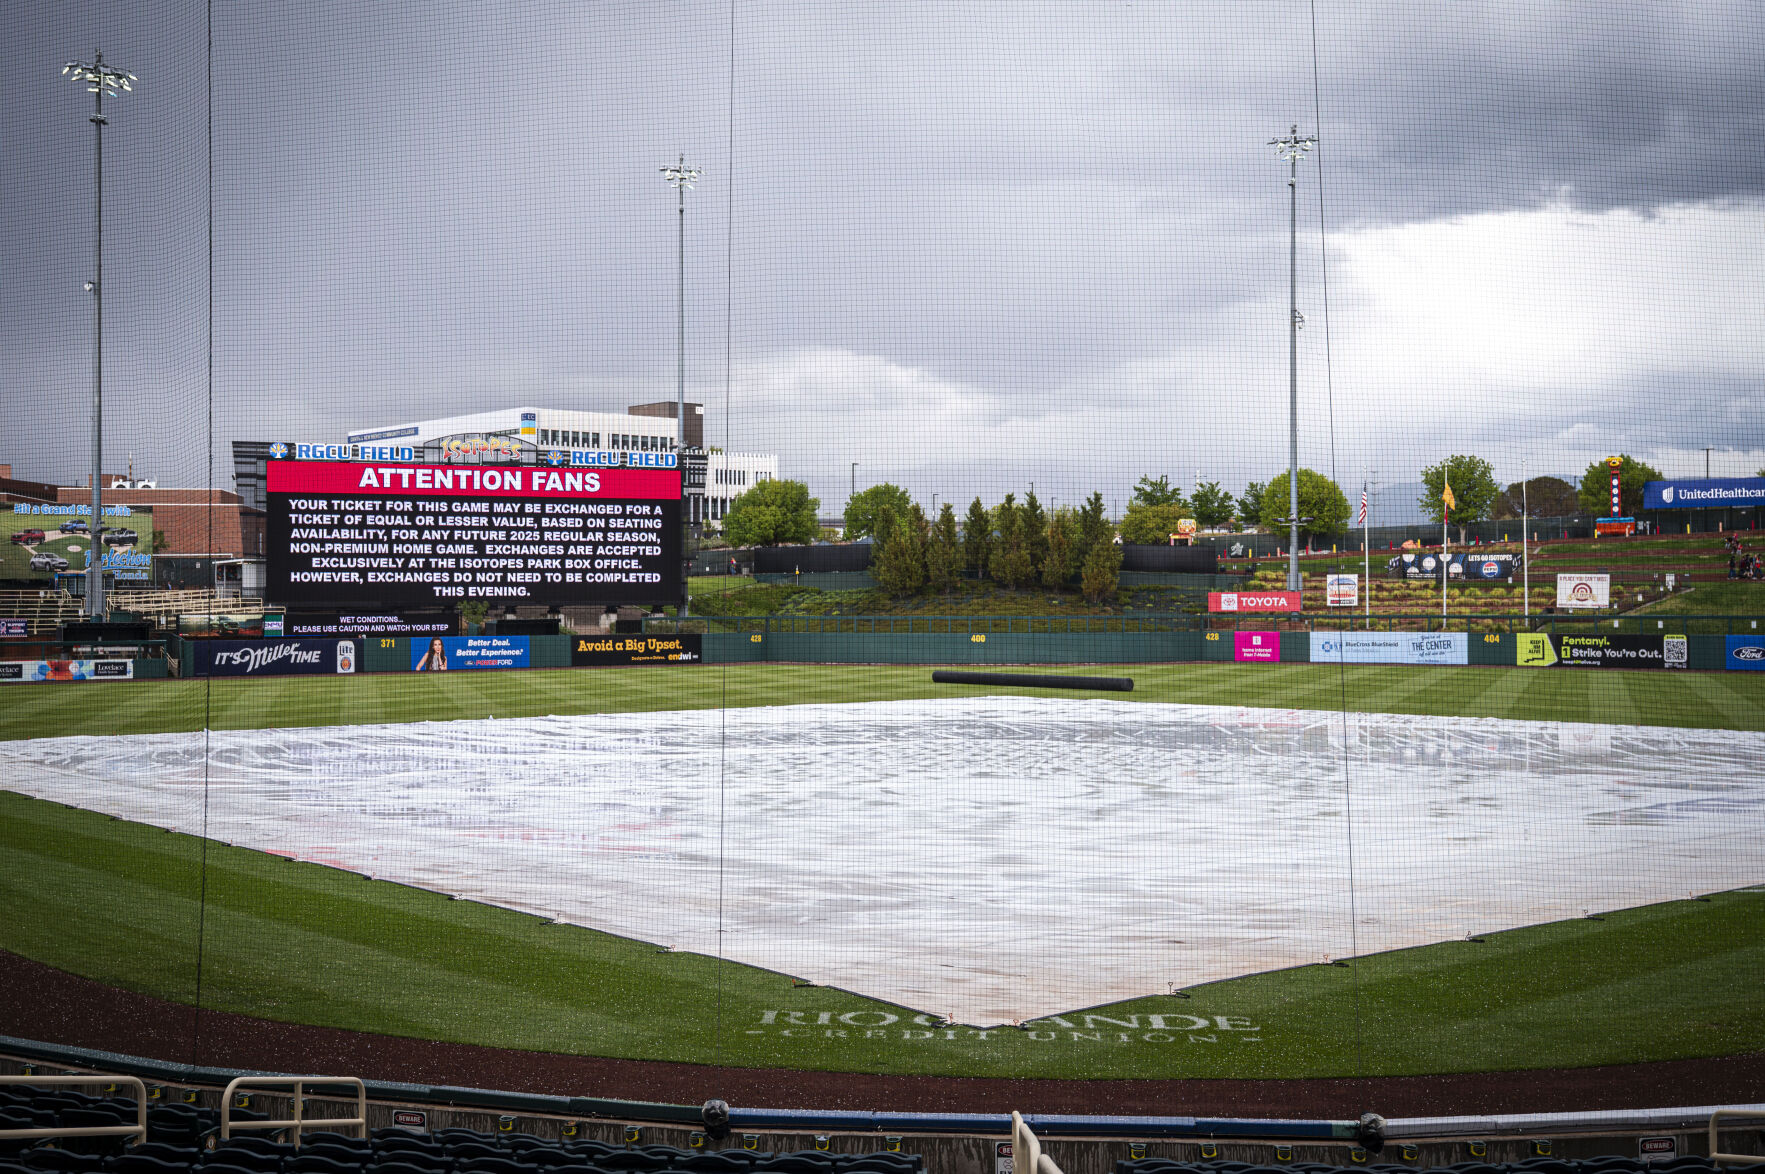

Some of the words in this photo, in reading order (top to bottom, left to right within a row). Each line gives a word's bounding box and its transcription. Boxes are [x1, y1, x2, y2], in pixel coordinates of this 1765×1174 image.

[296, 443, 352, 459] RGCU
[359, 445, 414, 461] FIELD
[571, 451, 620, 466] RGCU
[628, 453, 677, 468] FIELD
[359, 468, 521, 490] ATTENTION
[533, 472, 600, 492] FANS
[14, 503, 30, 514] Hit
[32, 505, 40, 514] a
[41, 504, 75, 515] Grand
[77, 504, 104, 515] Sla
[106, 505, 131, 516] with
[289, 500, 327, 510] YOUR
[332, 500, 382, 510] TICKET
[386, 501, 413, 511] FOR
[417, 502, 448, 511] THIS
[452, 503, 489, 512] GAME
[494, 503, 521, 512] MAY
[525, 504, 541, 513] BE
[546, 504, 622, 514] EXCHANGED
[626, 505, 650, 514] FOR
[654, 506, 662, 515] A
[289, 514, 340, 524] TICKET
[344, 515, 362, 524] OF
[367, 515, 411, 525] EQUAL
[416, 516, 434, 525] OR
[439, 516, 488, 526] LESSER
[492, 517, 537, 529] VALUE,
[542, 518, 583, 527] BASED
[587, 518, 605, 527] ON
[609, 519, 662, 528] SEATING
[291, 529, 387, 541] AVAILABILITY,
[392, 530, 418, 539] FOR
[422, 530, 450, 540] ANY
[454, 530, 506, 540] FUTURE
[510, 531, 540, 540] 2025
[544, 532, 603, 541] REGULAR
[607, 532, 660, 544] SEASON,
[291, 543, 388, 553] NON-PREMIUM
[393, 544, 432, 553] HOME
[436, 544, 477, 554] GAME.
[486, 545, 564, 554] EXCHANGES
[568, 546, 593, 554] ARE
[597, 546, 661, 555] ACCEPTED
[84, 547, 151, 567] Prfection
[312, 558, 404, 567] EXCLUSIVELY
[409, 558, 425, 568] AT
[429, 559, 455, 568] THE
[460, 559, 523, 568] ISOTOPES
[528, 559, 561, 568] PARK
[565, 559, 591, 568] BOX
[595, 559, 642, 569] OFFICE.
[291, 572, 363, 584] HOWEVER,
[368, 572, 449, 582] EXCHANGES
[454, 573, 472, 582] DO
[477, 573, 503, 582] NOT
[507, 573, 541, 582] NEED
[545, 573, 562, 582] TO
[566, 573, 582, 582] BE
[586, 573, 660, 582] COMPLETED
[433, 587, 464, 596] THIS
[469, 587, 530, 596] EVENING.
[1241, 597, 1288, 607] TOYOTA
[751, 635, 762, 643] 428
[971, 635, 986, 643] 400
[1206, 633, 1219, 641] 428
[1484, 634, 1500, 643] 404
[1562, 636, 1610, 647] Fentanyl.
[381, 639, 395, 648] 371
[578, 640, 613, 651] Avoid
[615, 642, 623, 651] a
[625, 639, 645, 652] Big
[647, 639, 683, 652] Upset.
[1412, 642, 1424, 651] THE
[1426, 640, 1452, 651] CENTER
[215, 652, 241, 665] IT'S
[239, 643, 300, 672] Miller
[290, 651, 321, 663] TIME
[1572, 648, 1602, 657] Strike
[1603, 648, 1636, 658] You're
[1639, 649, 1662, 658] Out.
[1740, 649, 1762, 658] Ford
[759, 1010, 899, 1026] RIO
